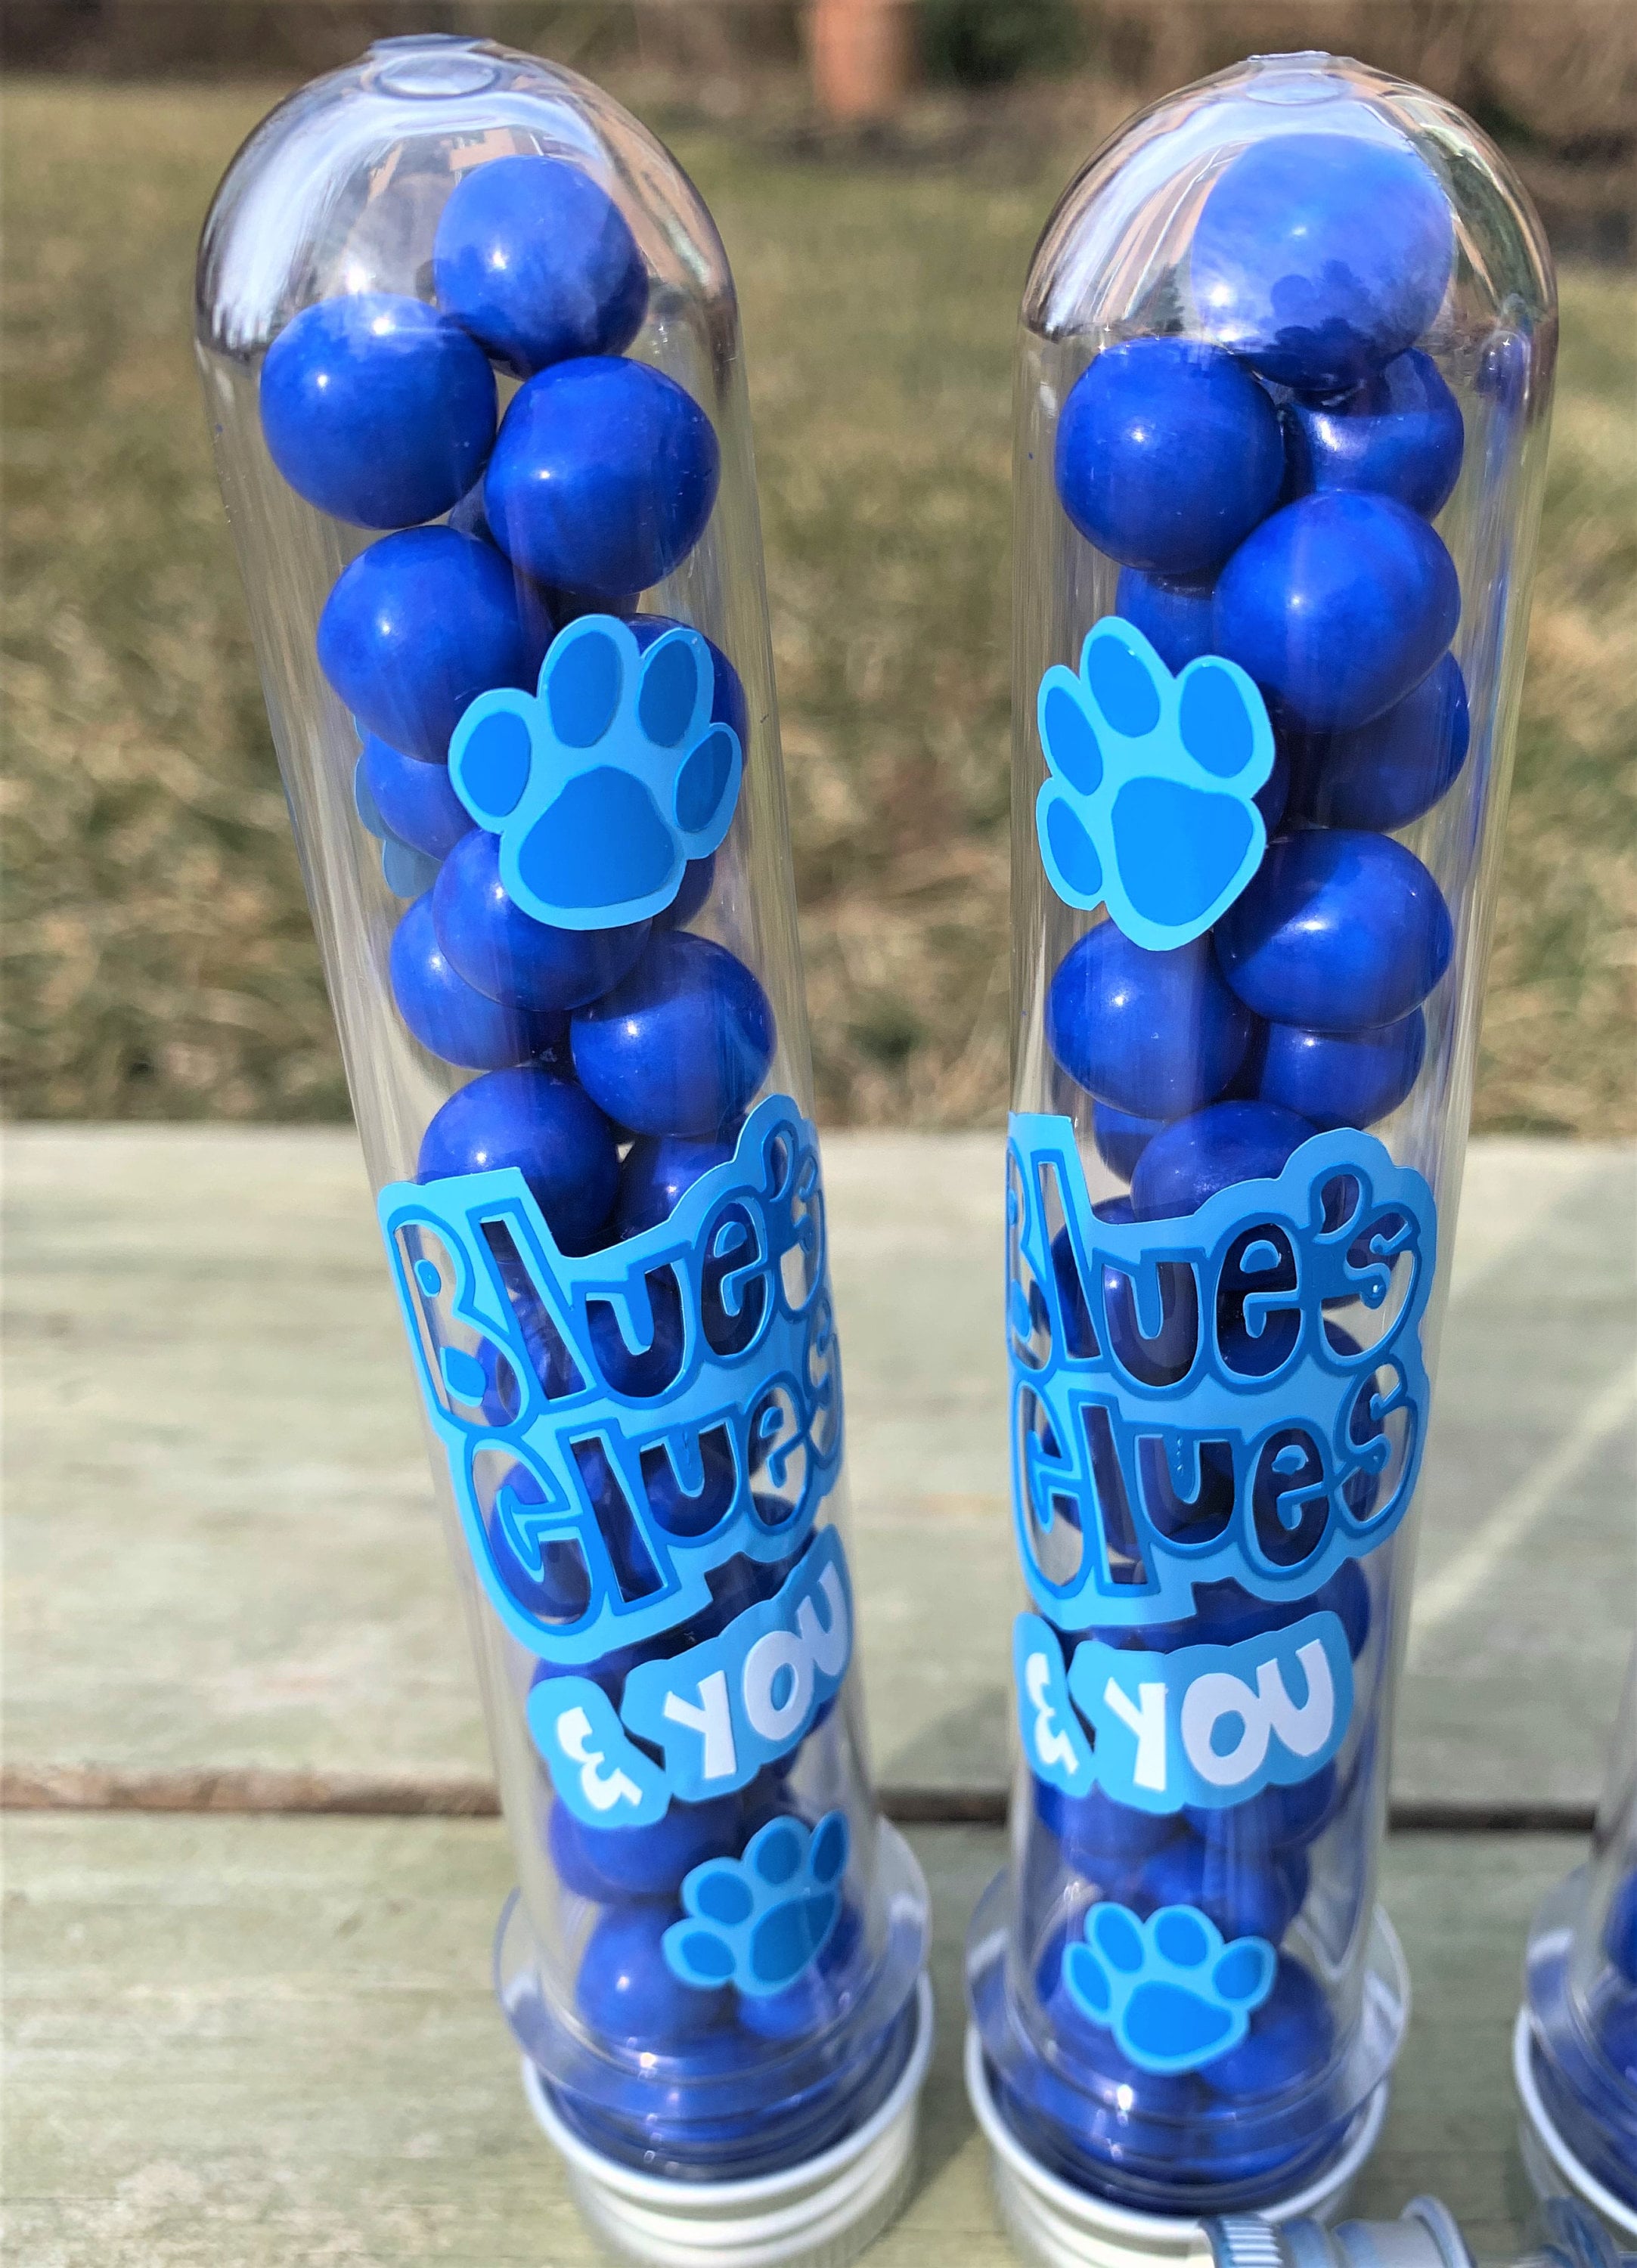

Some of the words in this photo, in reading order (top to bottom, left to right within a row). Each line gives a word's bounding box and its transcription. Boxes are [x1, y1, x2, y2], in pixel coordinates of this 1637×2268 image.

[386, 1119, 826, 1438] Blue's
[1006, 1137, 1422, 1399] Blue's
[461, 1299, 843, 1637] Clues
[1011, 1354, 1420, 1599] Clues
[1103, 1638, 1335, 1792] YOU
